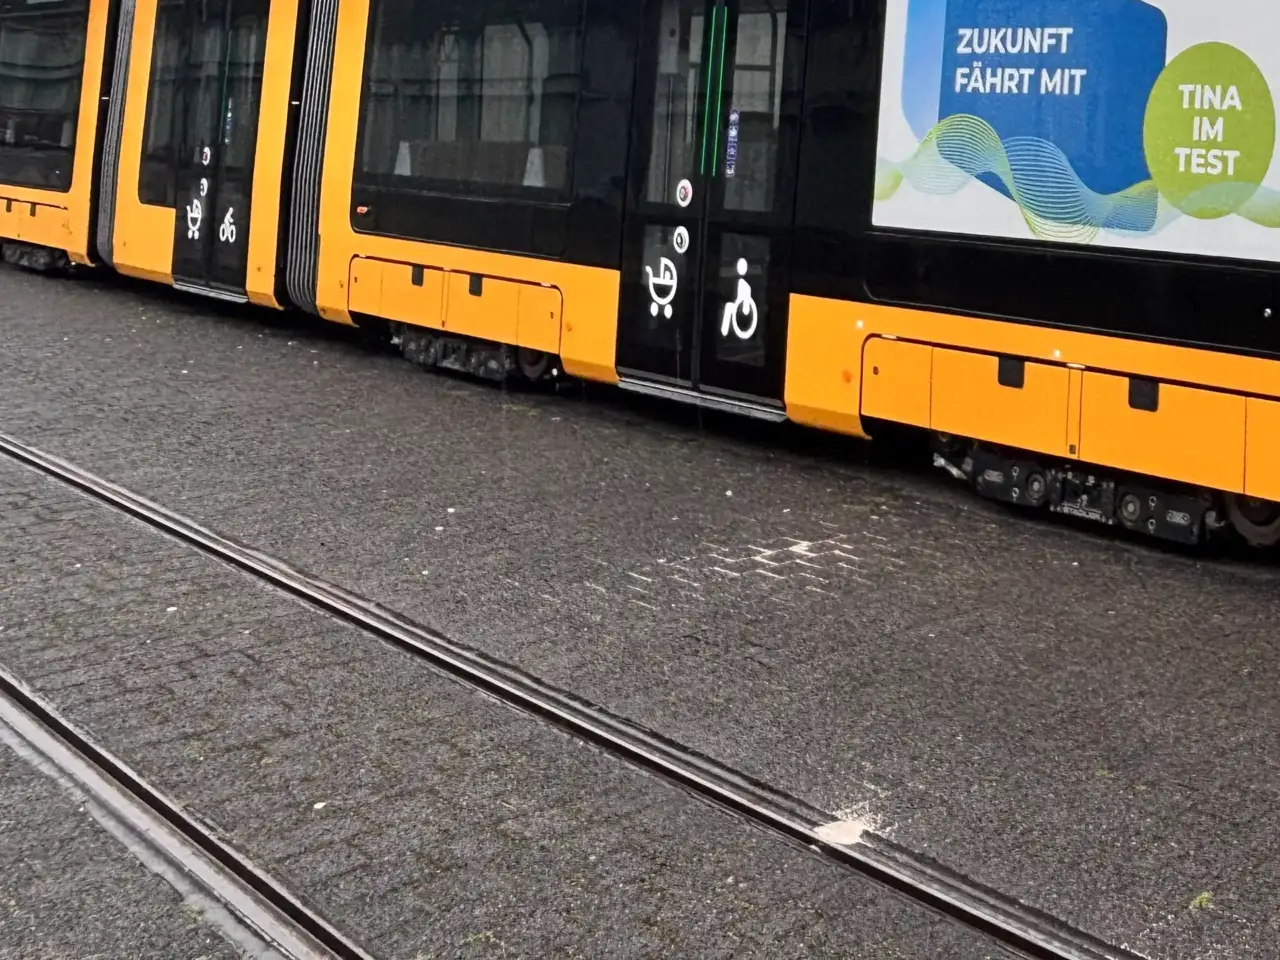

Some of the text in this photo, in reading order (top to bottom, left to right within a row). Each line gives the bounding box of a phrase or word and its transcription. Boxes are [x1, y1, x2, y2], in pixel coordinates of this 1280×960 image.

[957, 27, 1073, 55] ZUKUNFT
[955, 60, 1087, 95] FÄHRT MIT
[1179, 84, 1242, 111] TINA
[1192, 116, 1224, 142] IM
[1174, 147, 1241, 176] TEST
